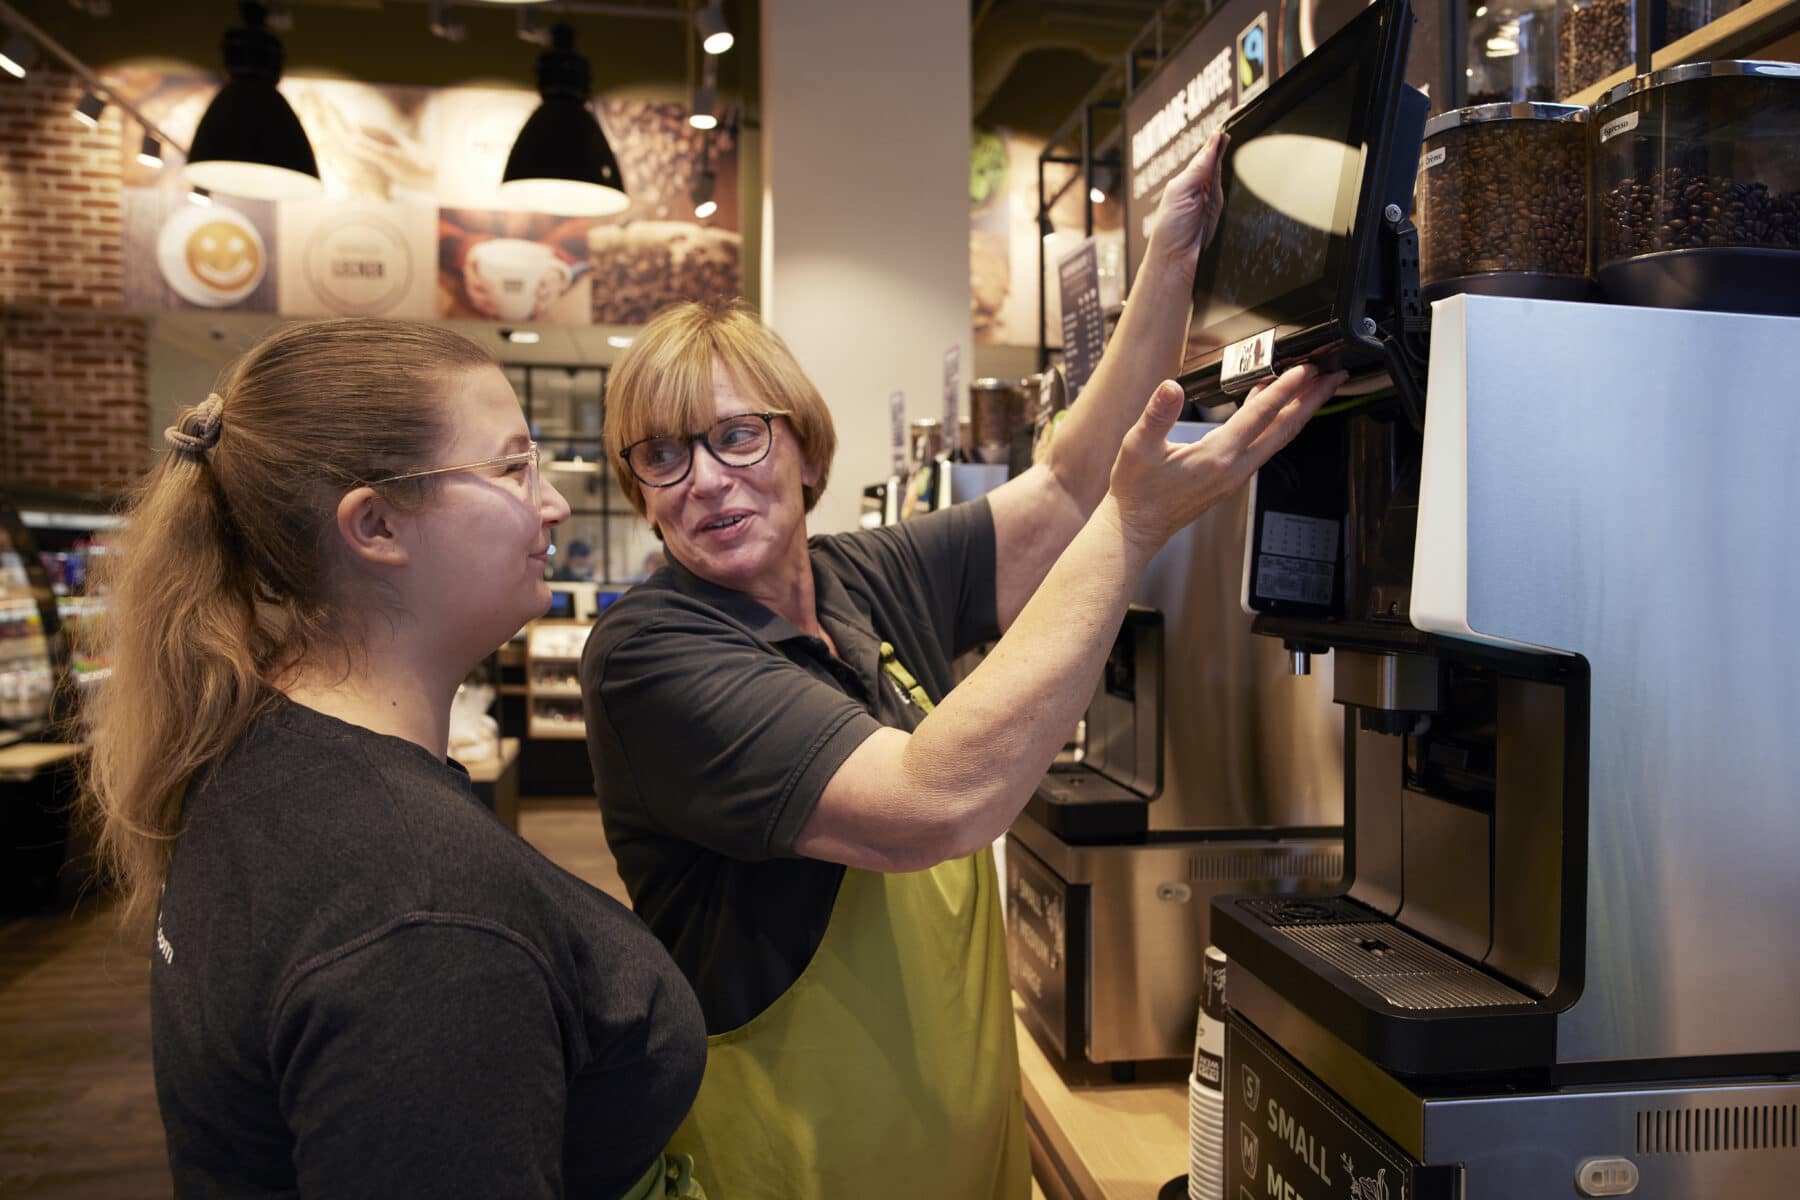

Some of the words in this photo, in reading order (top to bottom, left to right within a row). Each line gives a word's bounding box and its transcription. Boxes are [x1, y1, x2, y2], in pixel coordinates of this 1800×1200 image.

[1246, 1076, 1254, 1097] S
[1244, 1136, 1254, 1159] M
[1267, 1098, 1332, 1187] SMALL
[1267, 1163, 1304, 1200] ME
